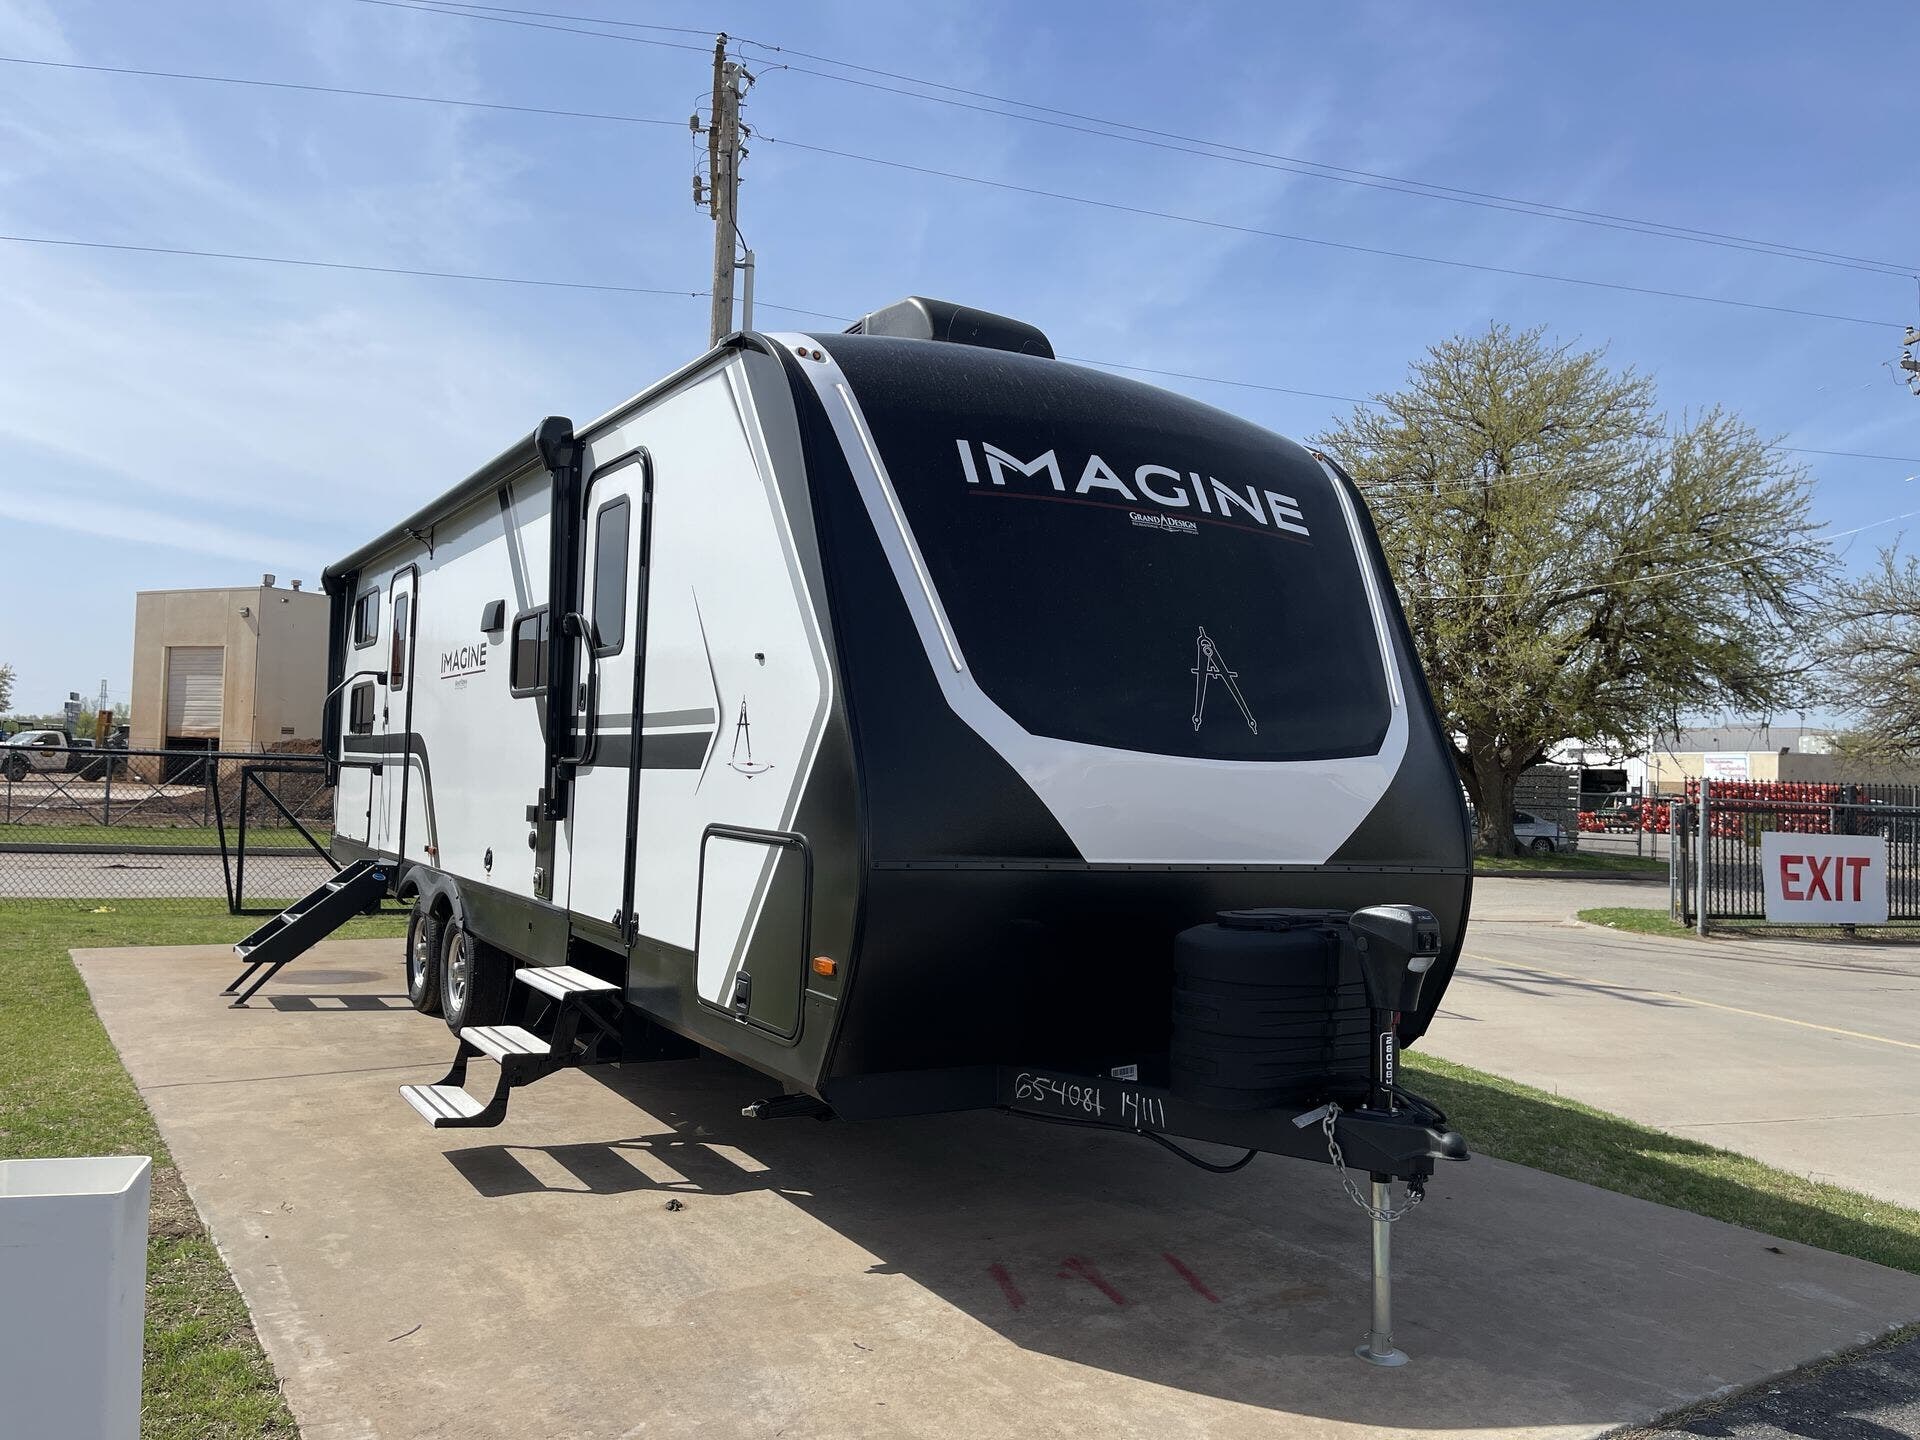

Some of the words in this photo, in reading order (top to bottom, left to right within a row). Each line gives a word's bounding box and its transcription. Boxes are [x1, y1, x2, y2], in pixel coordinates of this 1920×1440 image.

[956, 440, 1309, 535] IMAGINE
[1129, 511, 1160, 524] GRAND
[1167, 517, 1197, 529] DESIGN
[441, 642, 487, 673] IMAGINE
[1780, 855, 1870, 901] EXIT
